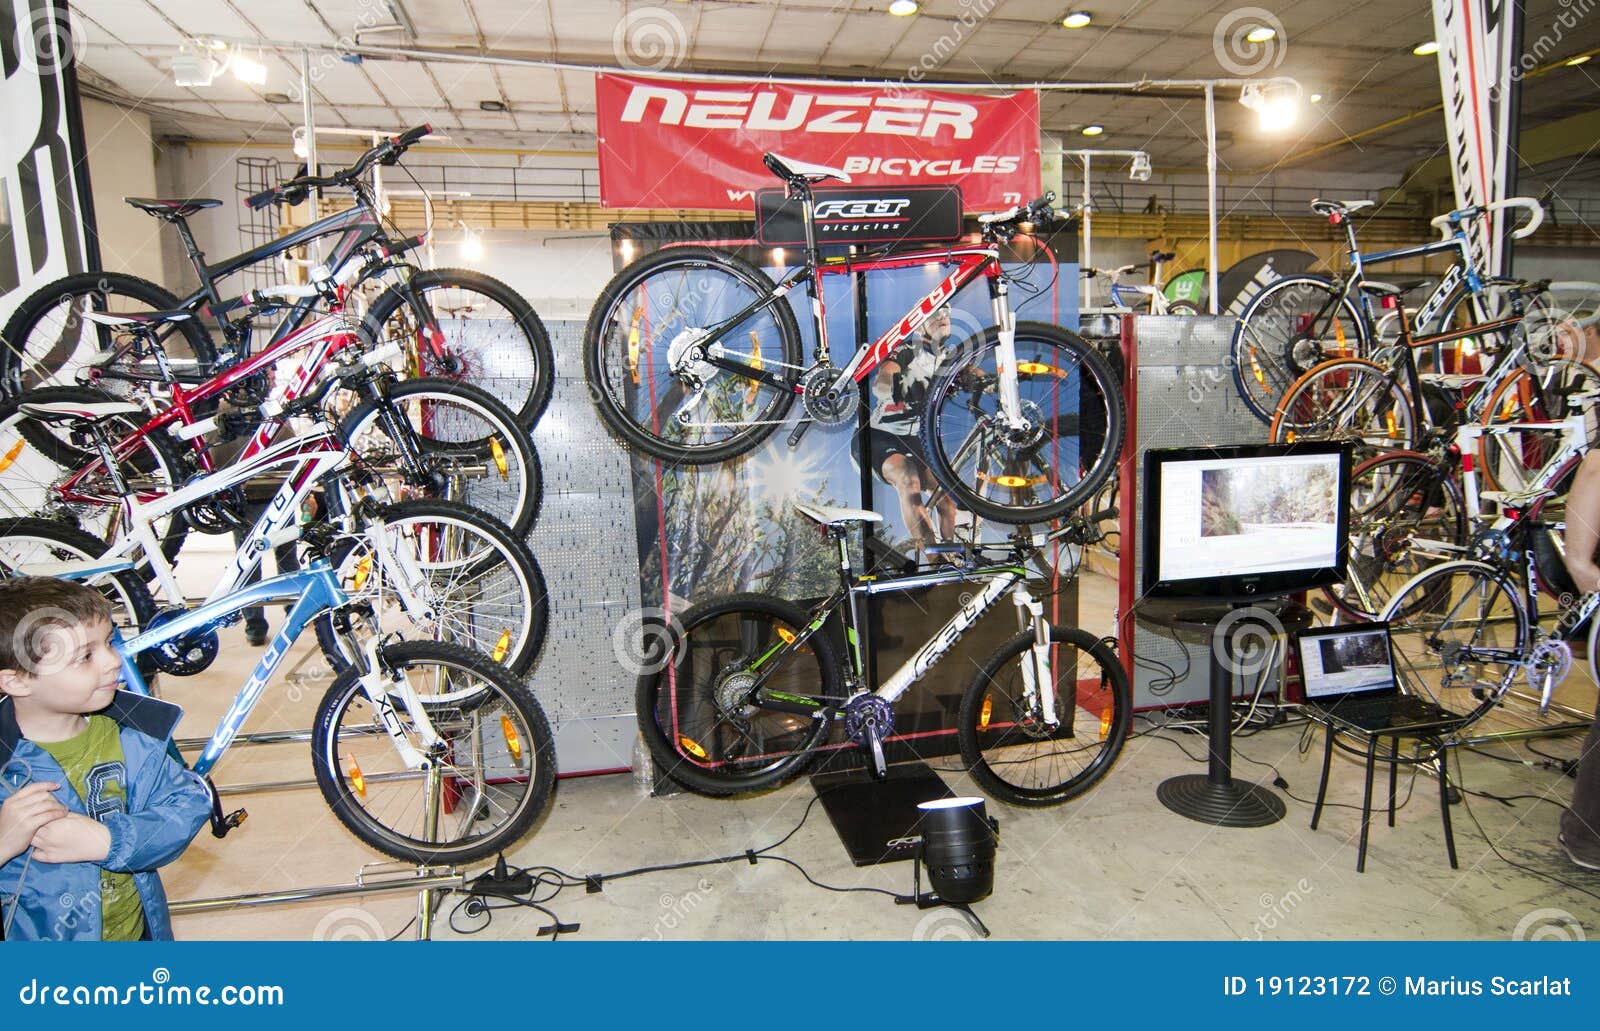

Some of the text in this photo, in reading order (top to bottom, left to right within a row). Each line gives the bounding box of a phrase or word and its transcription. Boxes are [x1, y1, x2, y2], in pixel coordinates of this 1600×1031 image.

[620, 85, 978, 139] NEUZER
[842, 155, 1021, 177] BICYCLES
[814, 199, 910, 218] FELT
[822, 223, 900, 232] bicycles
[874, 268, 960, 364] FELT
[1415, 265, 1461, 334] FELT
[914, 584, 991, 678] FELT
[375, 694, 408, 739] XCT
